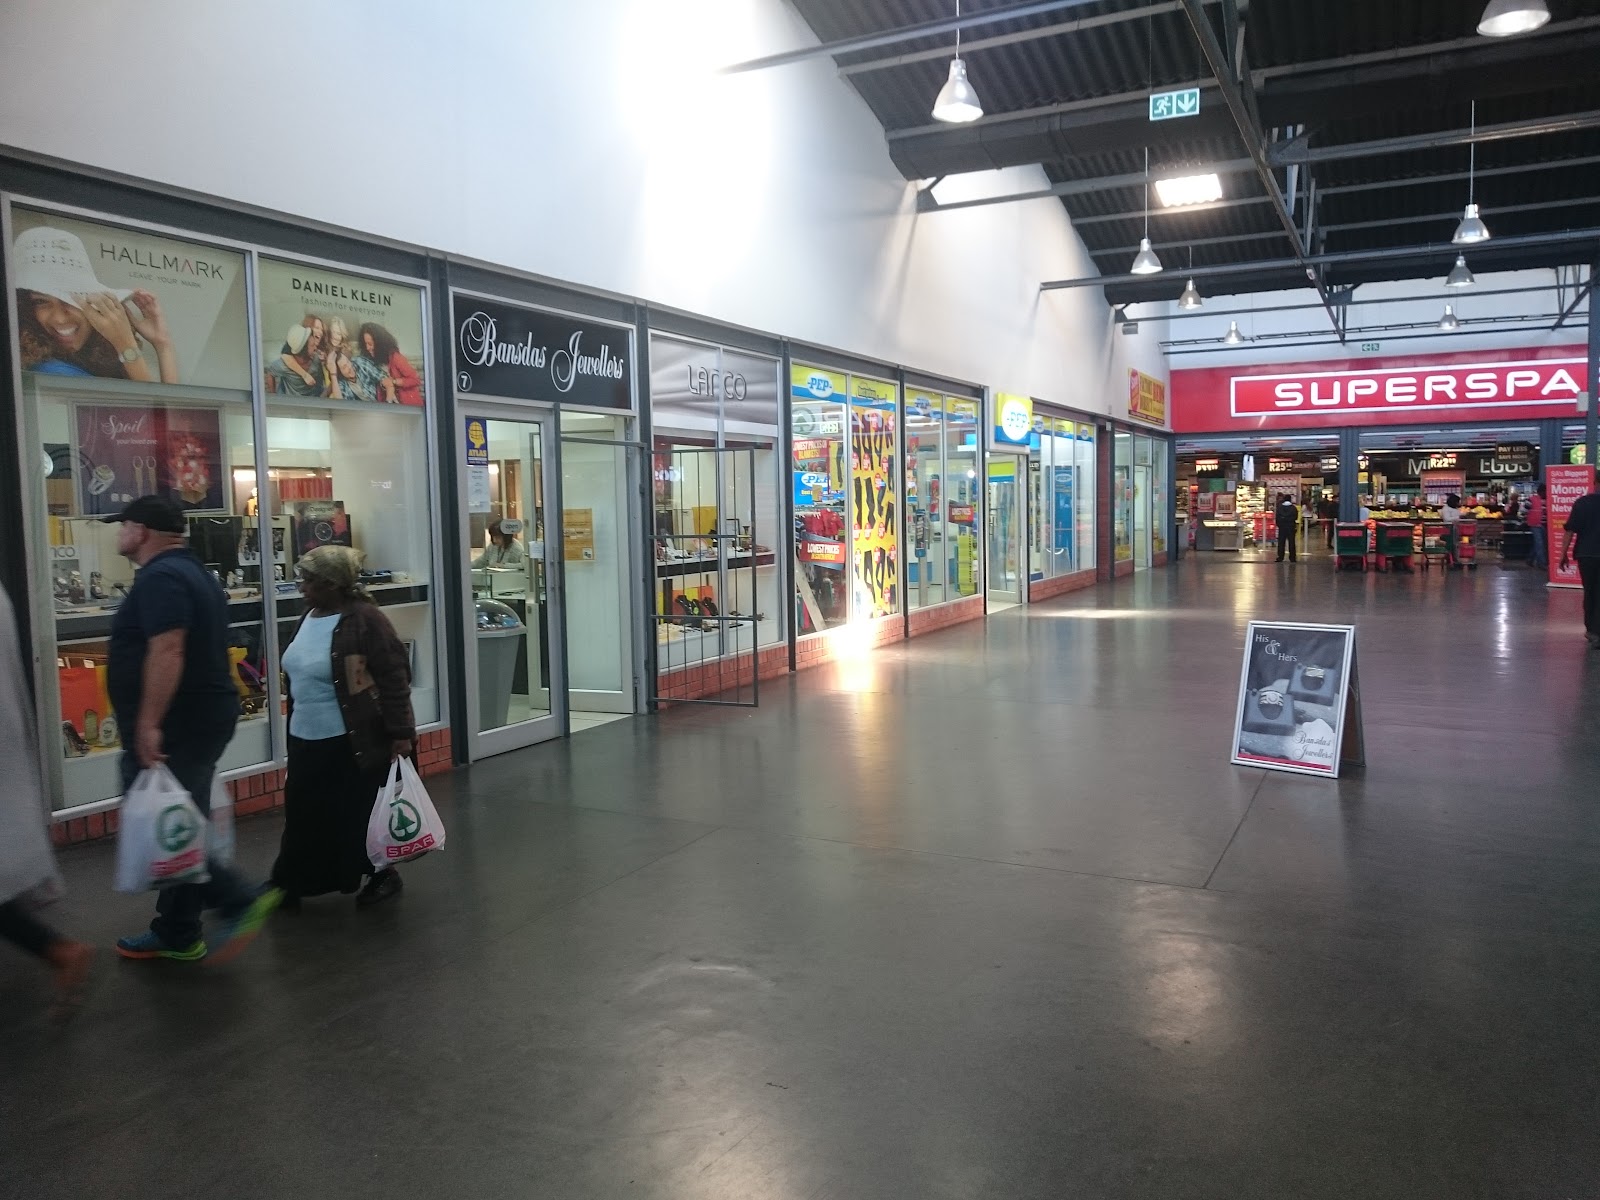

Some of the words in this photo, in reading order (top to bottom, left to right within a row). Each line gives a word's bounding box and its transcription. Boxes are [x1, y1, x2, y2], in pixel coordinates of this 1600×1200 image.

[100, 242, 224, 280] HALLMARK
[128, 271, 154, 281] LEAVE
[157, 275, 178, 285] YOUR
[181, 279, 202, 289] MARK
[292, 278, 348, 299] DANIEL
[351, 289, 392, 307] KLEIN
[301, 295, 333, 308] fashion
[334, 301, 347, 311] for
[349, 304, 386, 318] everyone
[460, 311, 547, 369] Bansdas
[551, 330, 624, 393] Jewellers
[461, 375, 468, 388] 7
[1274, 368, 1581, 408] SUPERSPA
[101, 414, 148, 440] Spoil
[468, 449, 487, 457] ATLAS
[1551, 485, 1588, 496] Money
[505, 523, 518, 531] open
[1255, 634, 1269, 642] His
[1278, 653, 1297, 662] Hers
[388, 834, 434, 857] SPAR
